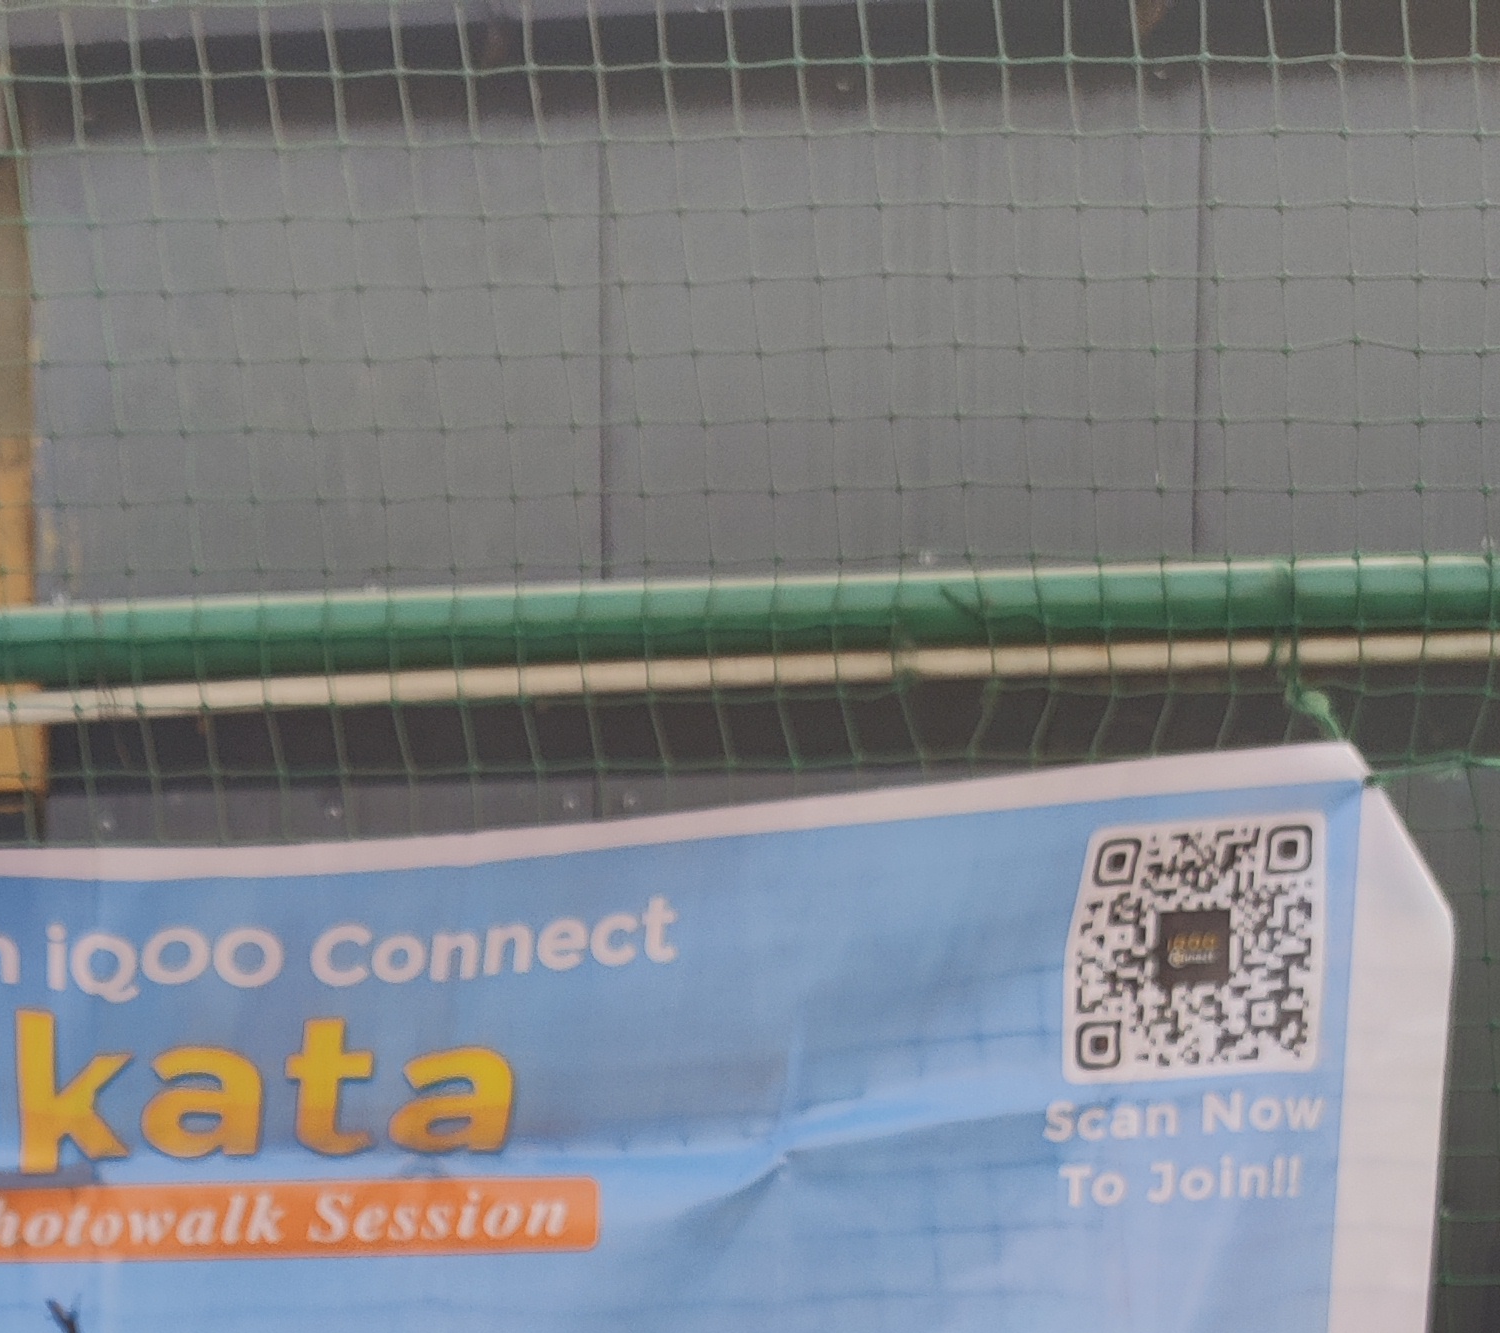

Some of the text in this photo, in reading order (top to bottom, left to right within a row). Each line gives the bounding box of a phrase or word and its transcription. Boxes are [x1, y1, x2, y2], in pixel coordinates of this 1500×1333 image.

[46, 922, 285, 1003] iQOO
[310, 897, 679, 988] Connect
[1043, 1089, 1326, 1144] Scan Now
[1059, 1154, 1301, 1209] To Join!!
[307, 1188, 570, 1245] Session
